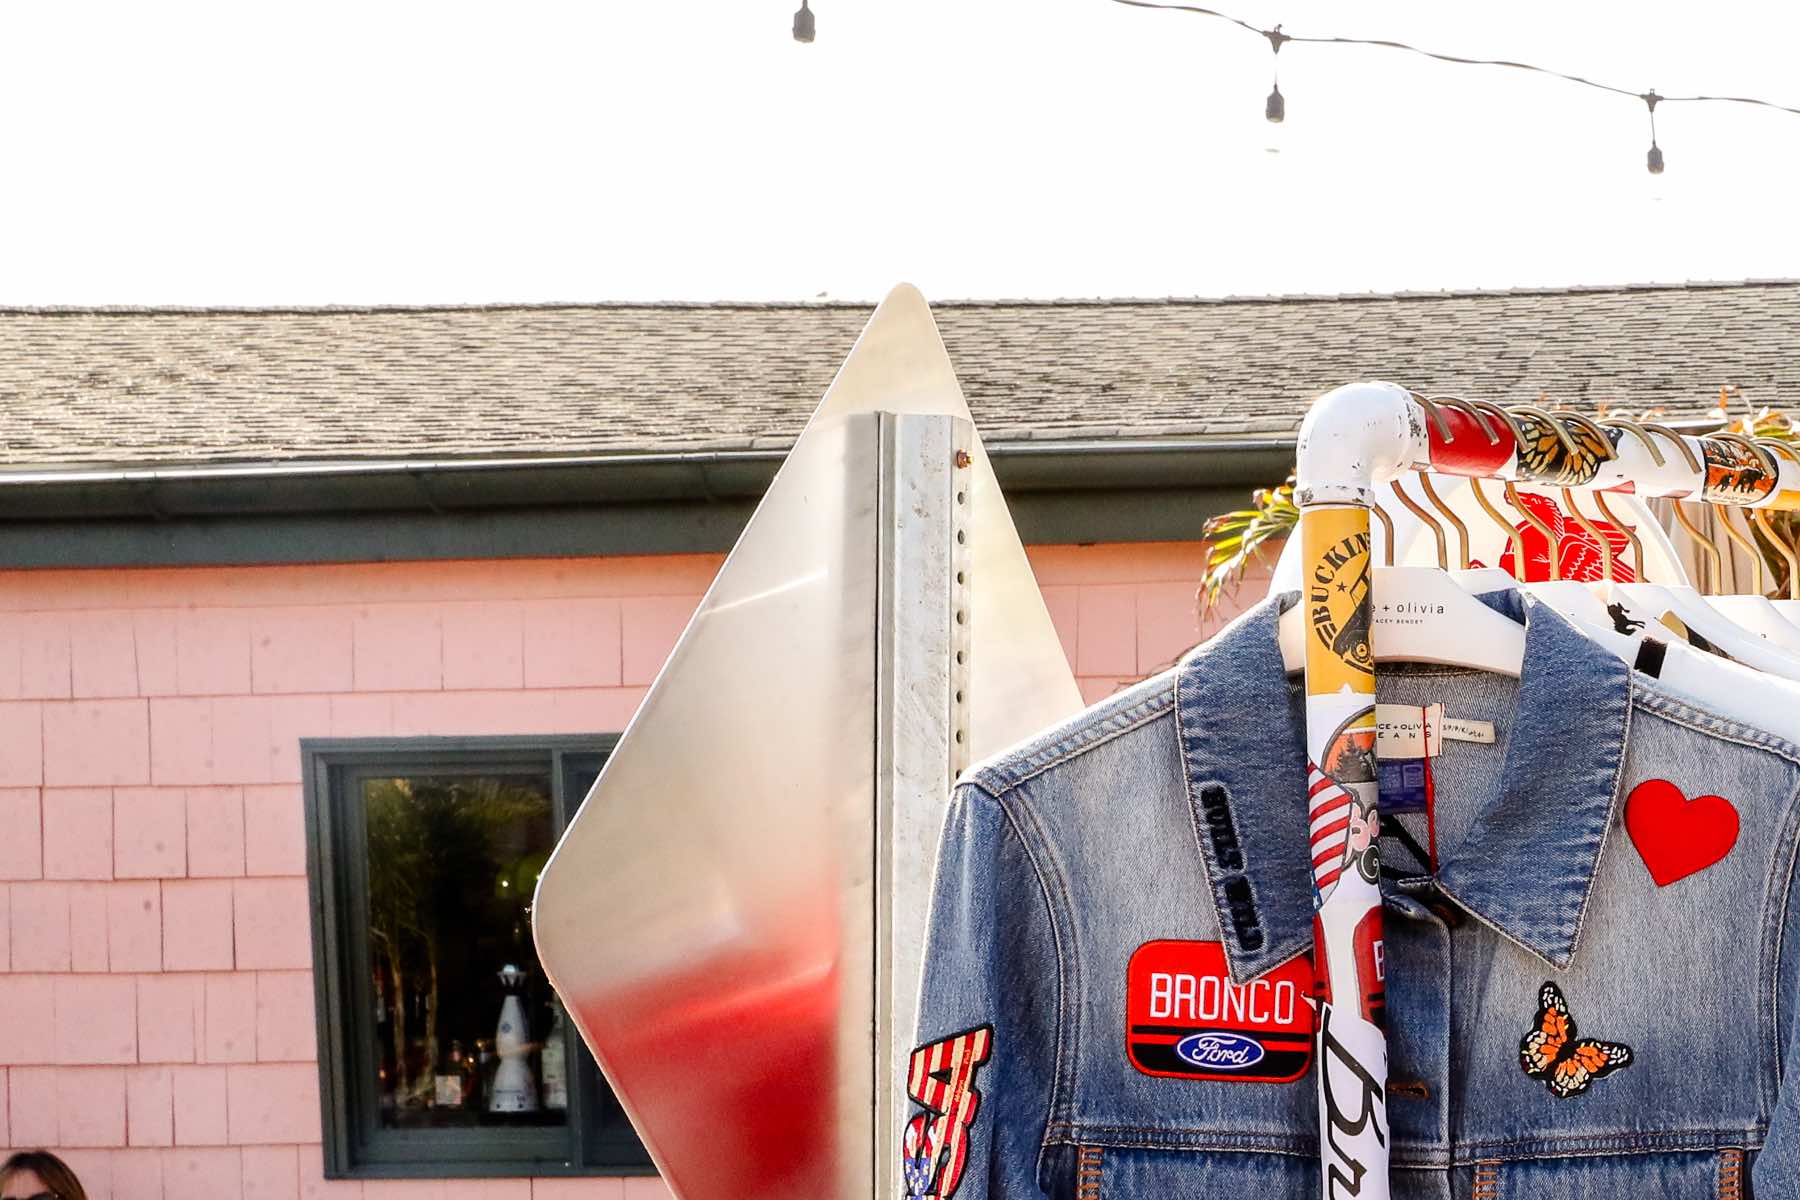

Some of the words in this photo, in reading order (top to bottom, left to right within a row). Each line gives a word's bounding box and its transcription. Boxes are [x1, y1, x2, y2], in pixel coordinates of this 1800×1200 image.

[1396, 602, 1445, 614] olivia
[1149, 971, 1296, 1025] BRONCO
[1188, 1036, 1254, 1068] Ford
